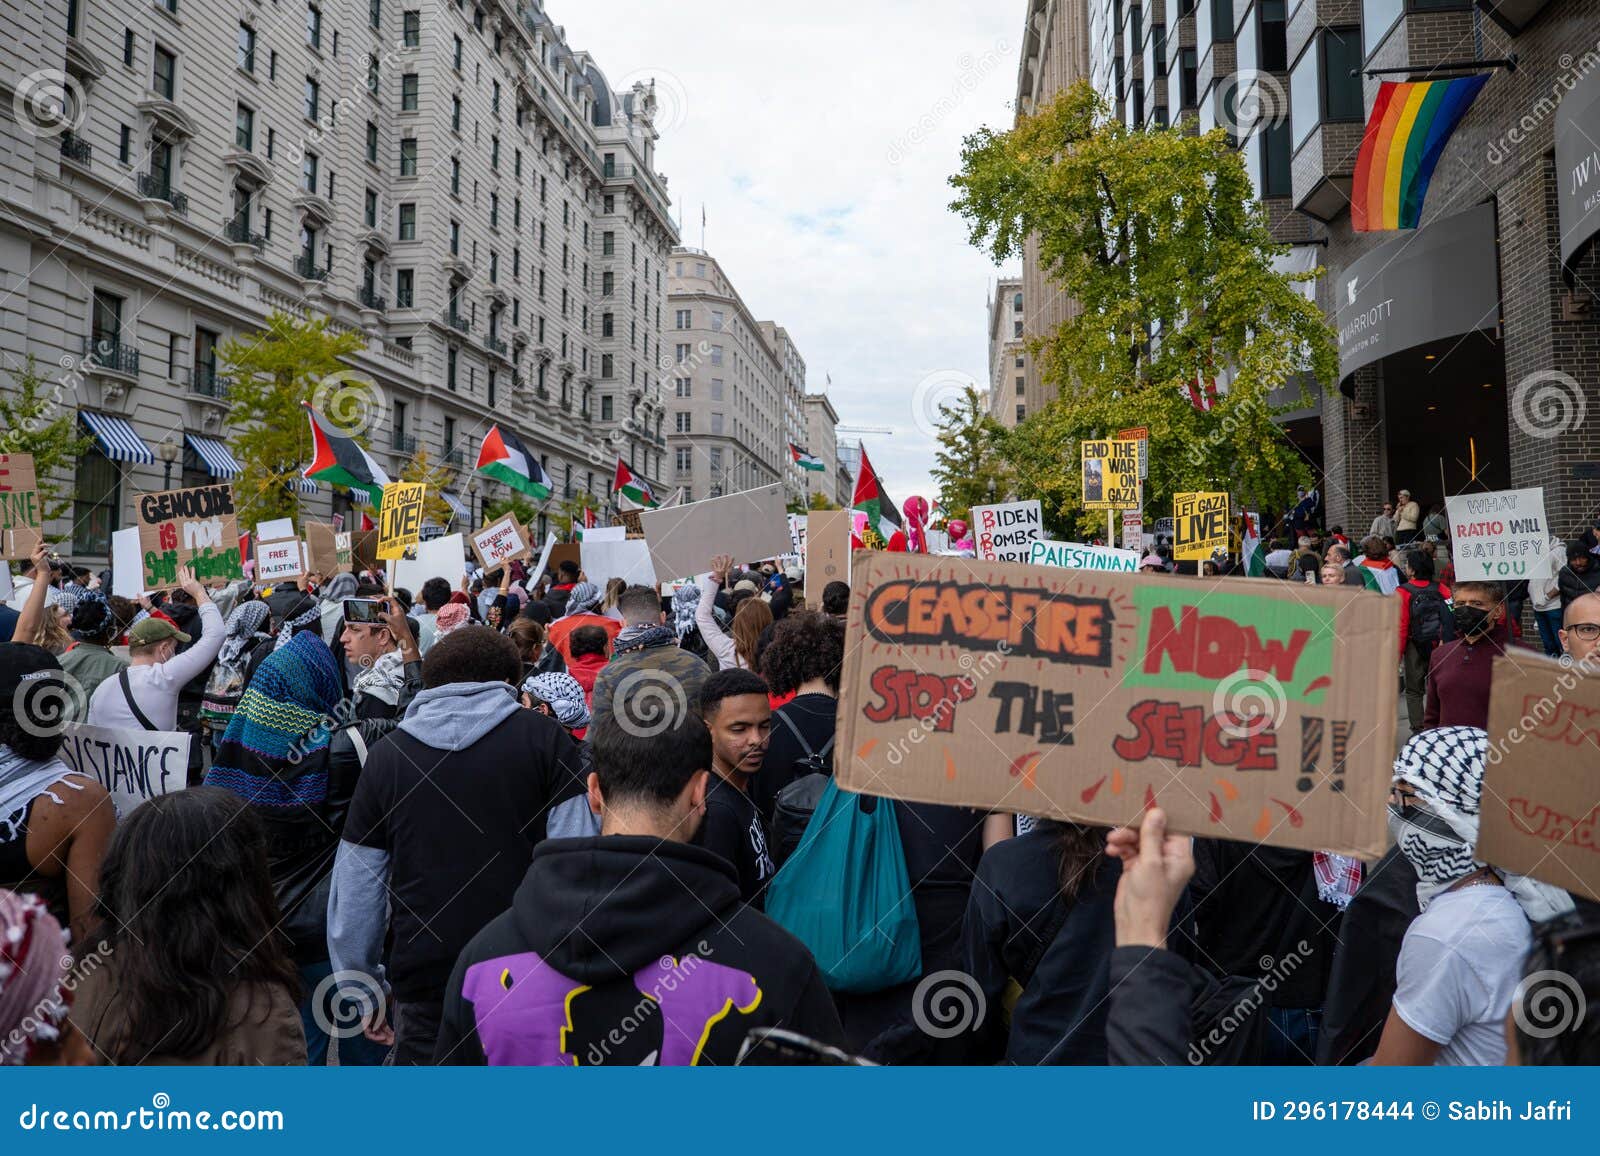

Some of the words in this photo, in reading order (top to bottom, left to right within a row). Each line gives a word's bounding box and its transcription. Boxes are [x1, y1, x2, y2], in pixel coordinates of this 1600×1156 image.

[1571, 156, 1590, 196] JW
[1084, 442, 1109, 458] END
[1112, 442, 1136, 458] THE
[1108, 459, 1136, 473] WAR
[1120, 474, 1137, 488] ON
[382, 493, 396, 511] LET
[397, 486, 422, 506] GAZA
[1107, 488, 1137, 502] GAZA
[1467, 495, 1518, 515] WHAT
[1175, 501, 1195, 518] LET
[1198, 495, 1226, 513] GAZA
[380, 502, 421, 542] LIVE!
[981, 507, 1039, 531] BIDEN
[1175, 509, 1227, 546] LIVE!
[1456, 520, 1504, 538] RATIO
[1509, 518, 1540, 535] WILL
[479, 526, 513, 550] CEASEFIRE
[980, 529, 1039, 554] BOMBS
[1462, 539, 1543, 558] SATISFY
[268, 549, 289, 560] FREE
[490, 541, 513, 560] NOW
[1030, 541, 1137, 572] PALESTINIAN
[260, 562, 299, 574] PALESTINE
[1482, 560, 1527, 576] YOU
[866, 580, 1112, 667] CEASEFIRE
[1143, 605, 1312, 682] NOW
[862, 665, 977, 733] STOP
[988, 680, 1075, 746] THE
[1113, 700, 1278, 772] SEIGE
